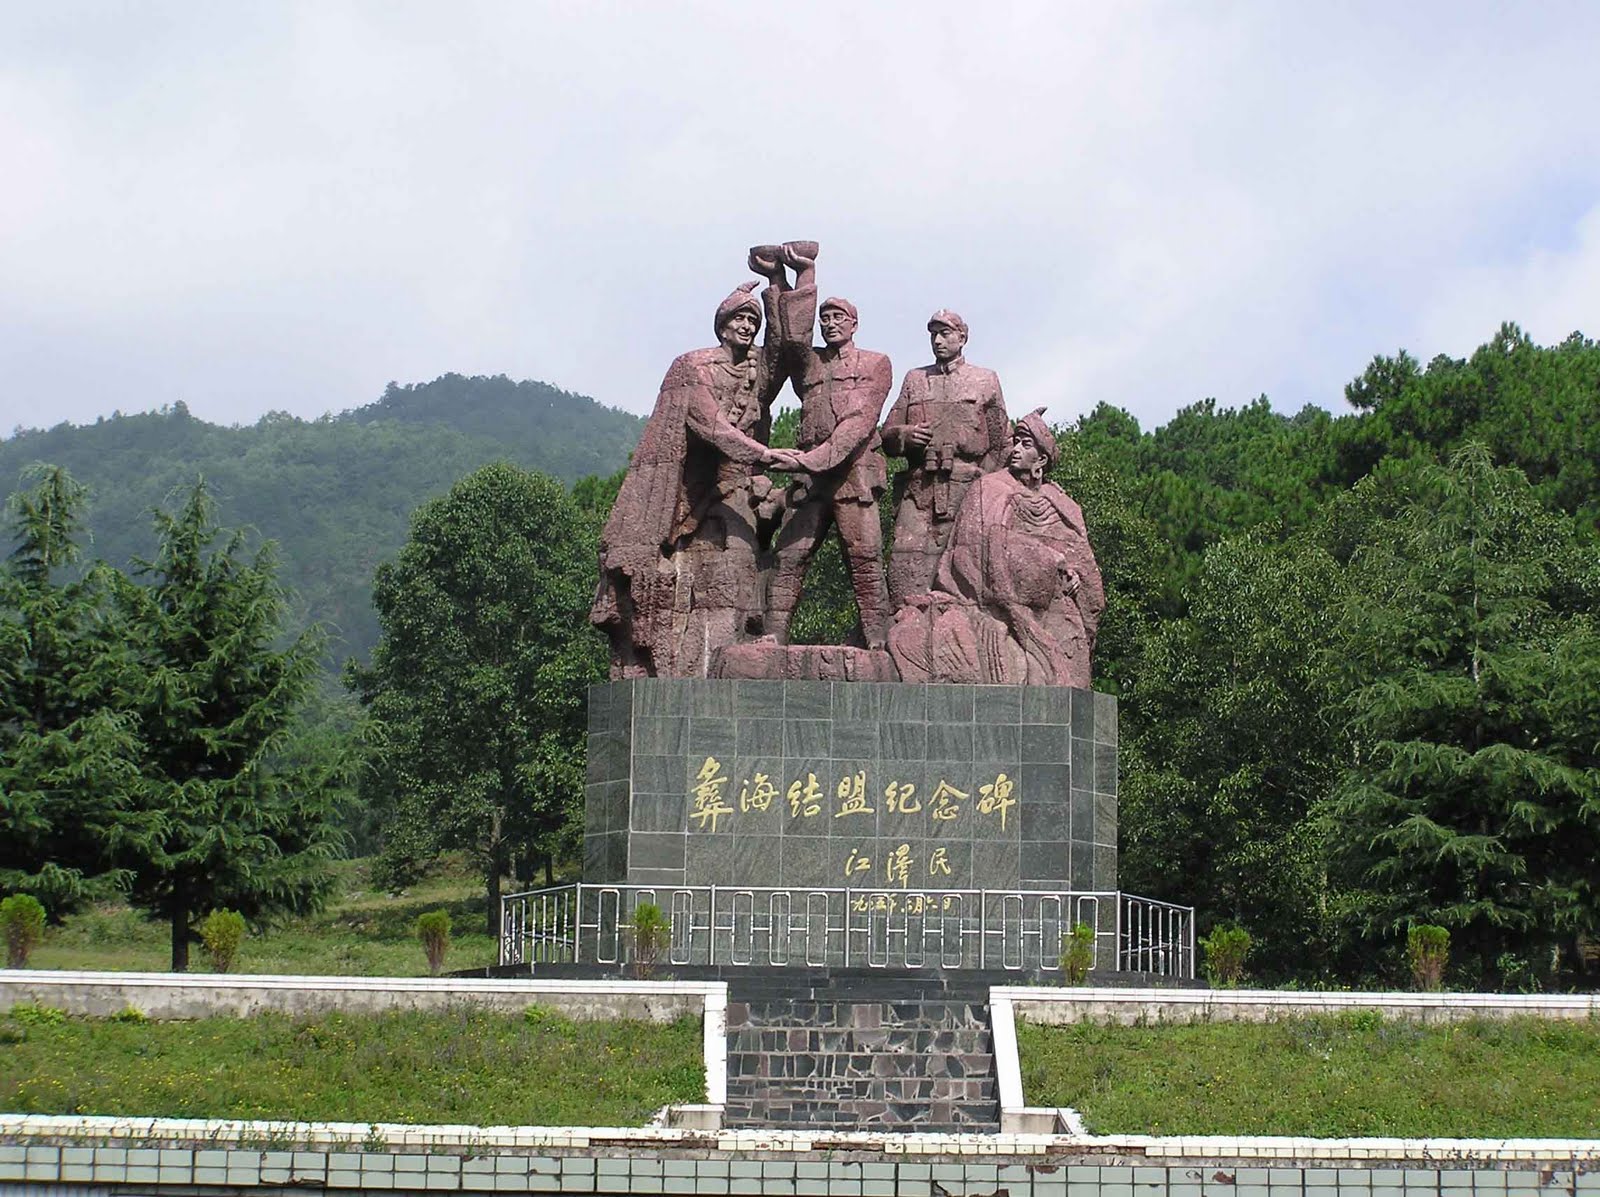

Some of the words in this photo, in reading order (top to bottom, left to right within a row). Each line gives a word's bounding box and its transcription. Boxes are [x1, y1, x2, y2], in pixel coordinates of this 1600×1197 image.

[690, 756, 1016, 832] 彝海结盟纪念碑
